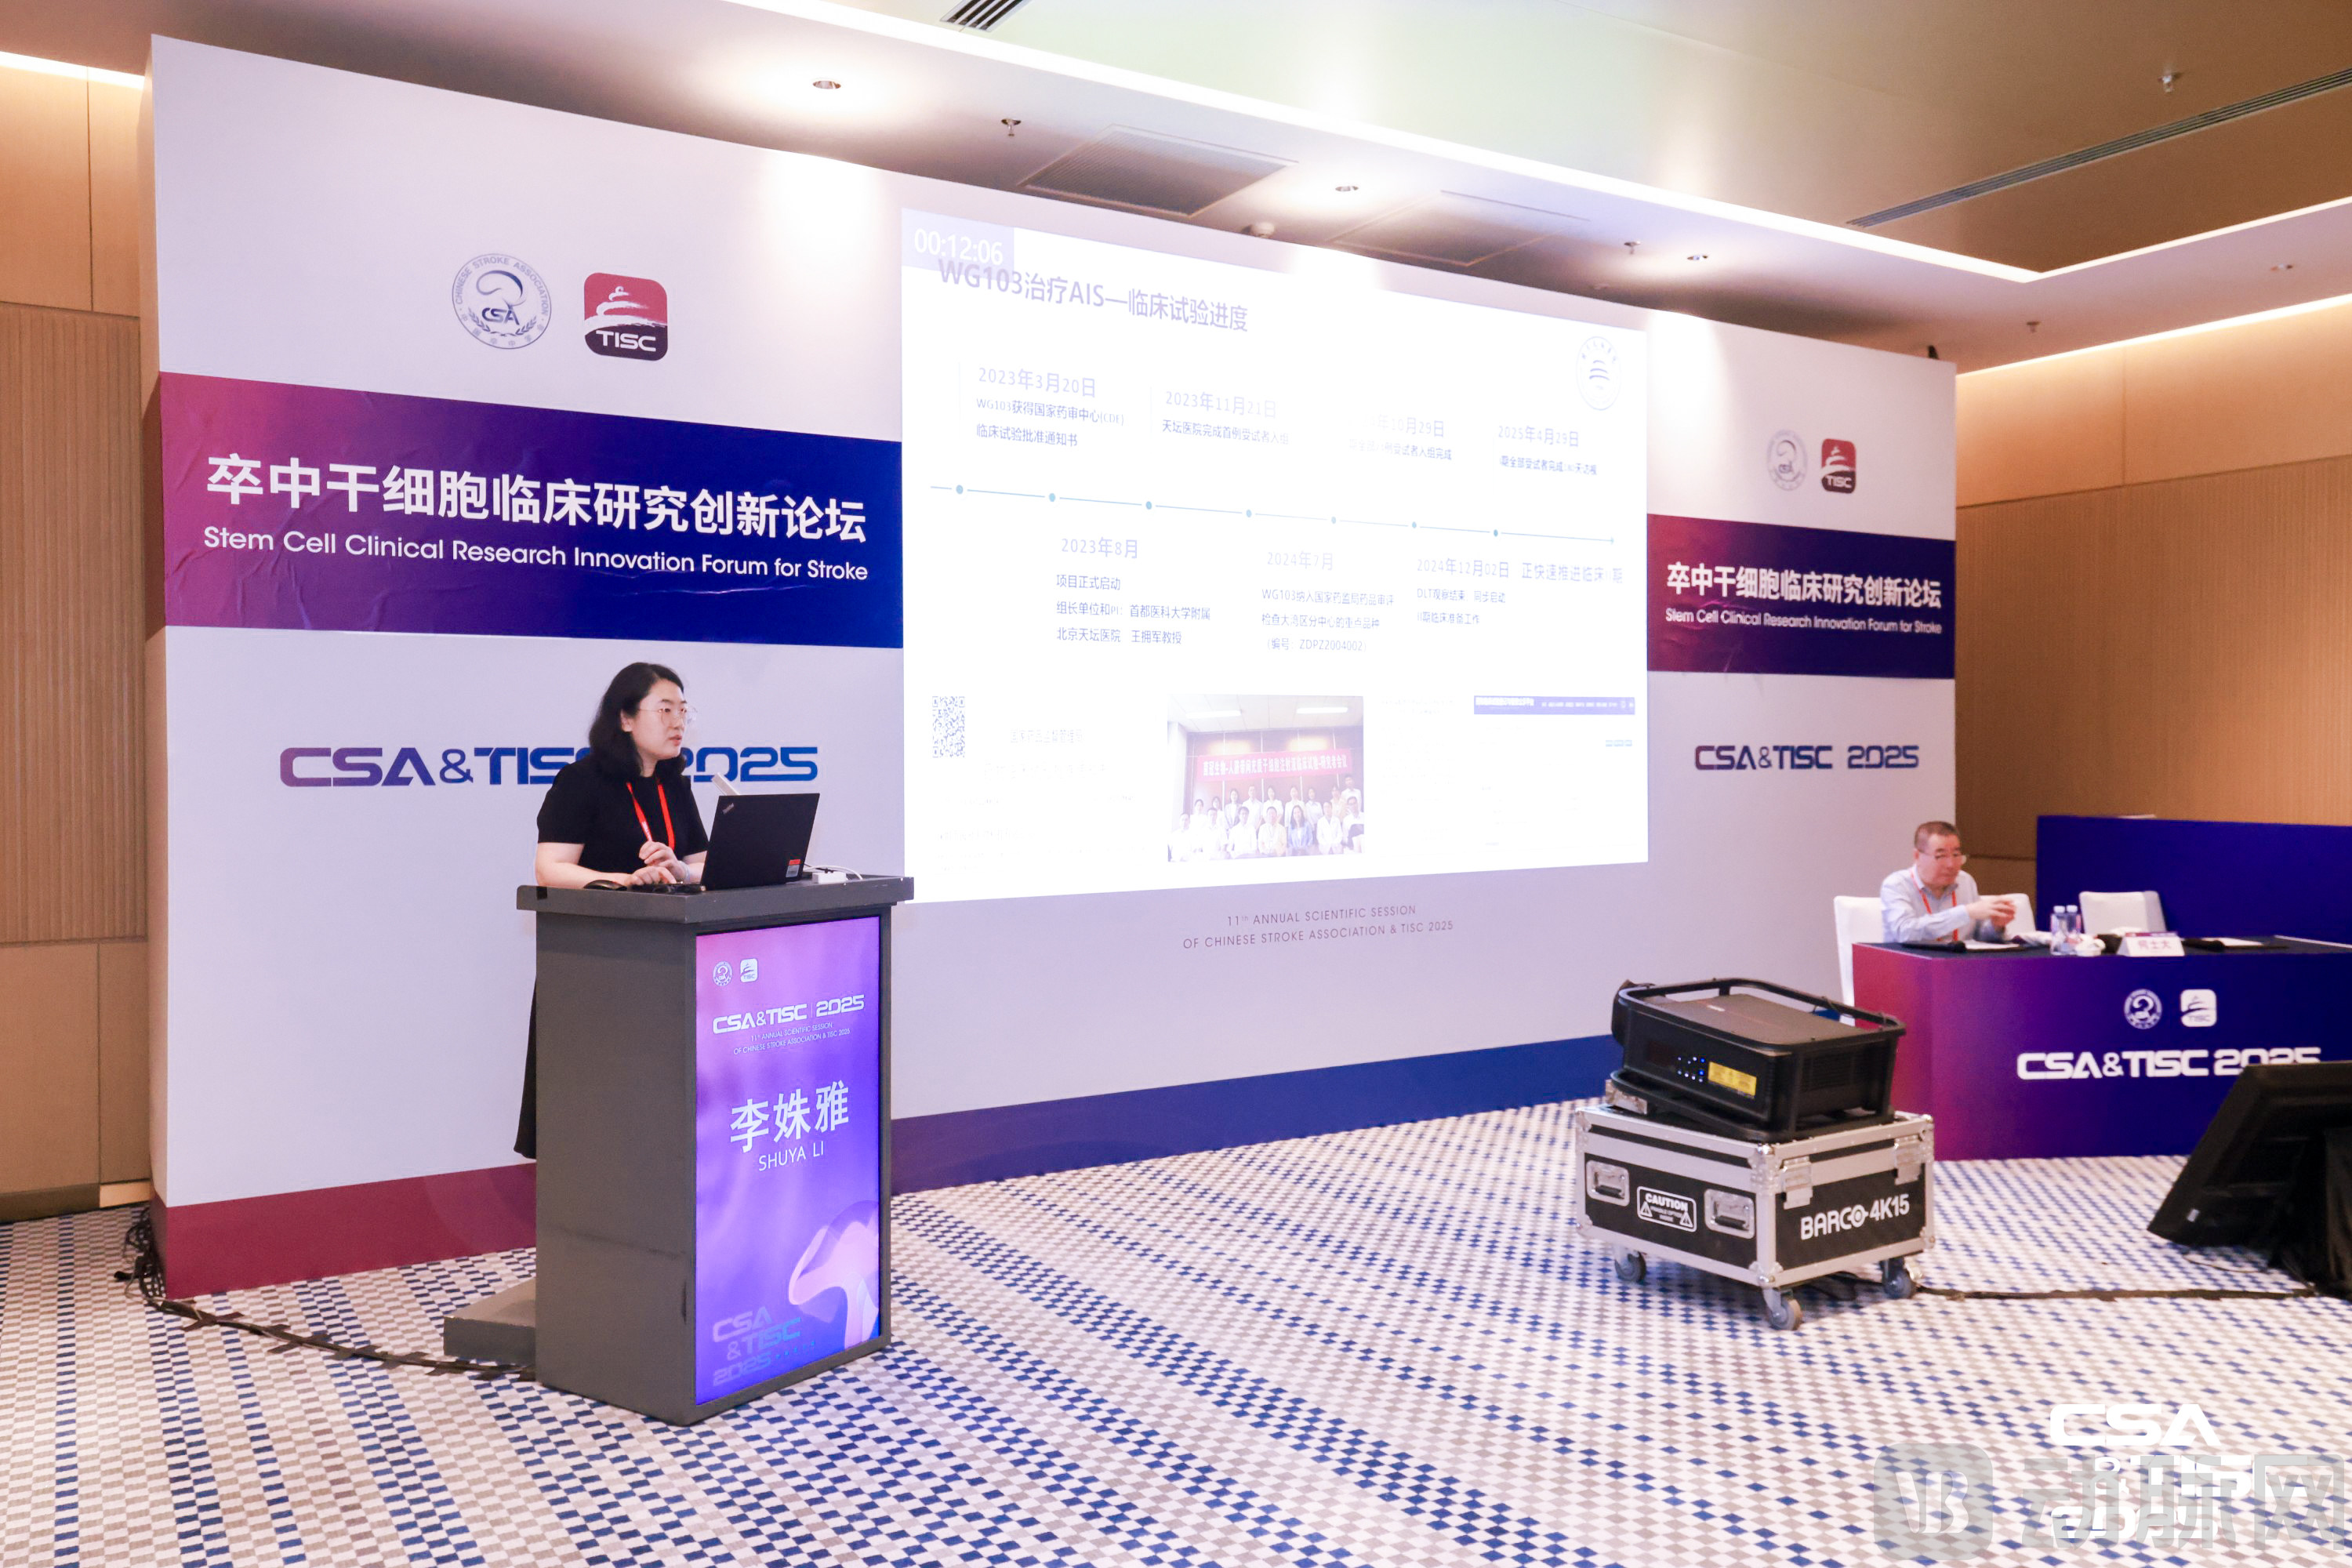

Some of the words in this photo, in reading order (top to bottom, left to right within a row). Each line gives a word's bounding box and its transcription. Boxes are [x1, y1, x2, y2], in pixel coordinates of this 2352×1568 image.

[914, 228, 1004, 266] 00:12:06
[472, 256, 510, 269] STROKE
[513, 262, 549, 316] ASSOCIATION
[596, 330, 656, 352] TISC
[978, 368, 1096, 398] 2023年3月20日
[1166, 390, 1276, 419] 2023年11月21日
[976, 423, 1078, 448] 临床试验批准通知书
[1826, 475, 1852, 488] TISC
[207, 453, 866, 543] 卒中干细胞临床研究创新论坛
[204, 526, 274, 550] Stem
[283, 531, 336, 554] Cell
[345, 534, 444, 559] Clinical
[452, 539, 566, 565] Research
[575, 546, 695, 572] Innovation
[702, 554, 768, 575] Forum
[775, 558, 801, 577] for
[808, 560, 868, 580] Stroke
[1061, 536, 1138, 558] 2023年8月
[1056, 574, 1121, 590] 项目正式启动
[1667, 561, 1942, 608] 卒中干细胞临床研究创新论坛
[1056, 626, 1121, 643] 北京天坛医院
[1665, 608, 1694, 622] Stem
[1696, 609, 1719, 623] Cell
[1720, 610, 1762, 626] Clinical
[1763, 612, 1812, 628] Research
[1813, 615, 1866, 631] Innovation
[1867, 617, 1898, 633] Forum
[1900, 619, 1912, 633] for
[1914, 620, 1943, 634] Stroke
[280, 747, 590, 787] CSA&TIS
[1846, 745, 1920, 769] 2025
[1253, 912, 1300, 925] ANNUAL
[1305, 908, 1367, 922] SCIENTIFIC
[1371, 905, 1416, 918] SESSION
[1182, 938, 1200, 949] OF
[1204, 934, 1256, 947] CHINESE
[1261, 931, 1305, 943] STROKE
[1308, 925, 1385, 941] ASSOCIATION
[1390, 924, 1397, 934] &
[1401, 922, 1424, 933] TISC
[1428, 920, 1454, 932] 2025
[815, 994, 866, 1017] 2025
[733, 1047, 742, 1055] OF
[742, 1044, 766, 1054] CHINESE
[767, 1040, 786, 1049] STROKE
[787, 1034, 822, 1046] ASSOCIATION
[761, 1031, 783, 1040] ANNUAL
[784, 1025, 811, 1036] SCIENTIFIC
[812, 1022, 833, 1032] SESSION
[730, 1080, 849, 1153] 李姝雅
[759, 1145, 806, 1172] SHUYA
[813, 1141, 824, 1157] LI
[1645, 1192, 1688, 1211] CAUTION
[1800, 1204, 1869, 1240] BARCO
[1869, 1193, 1911, 1221] 4K15
[713, 1306, 772, 1343] CSA
